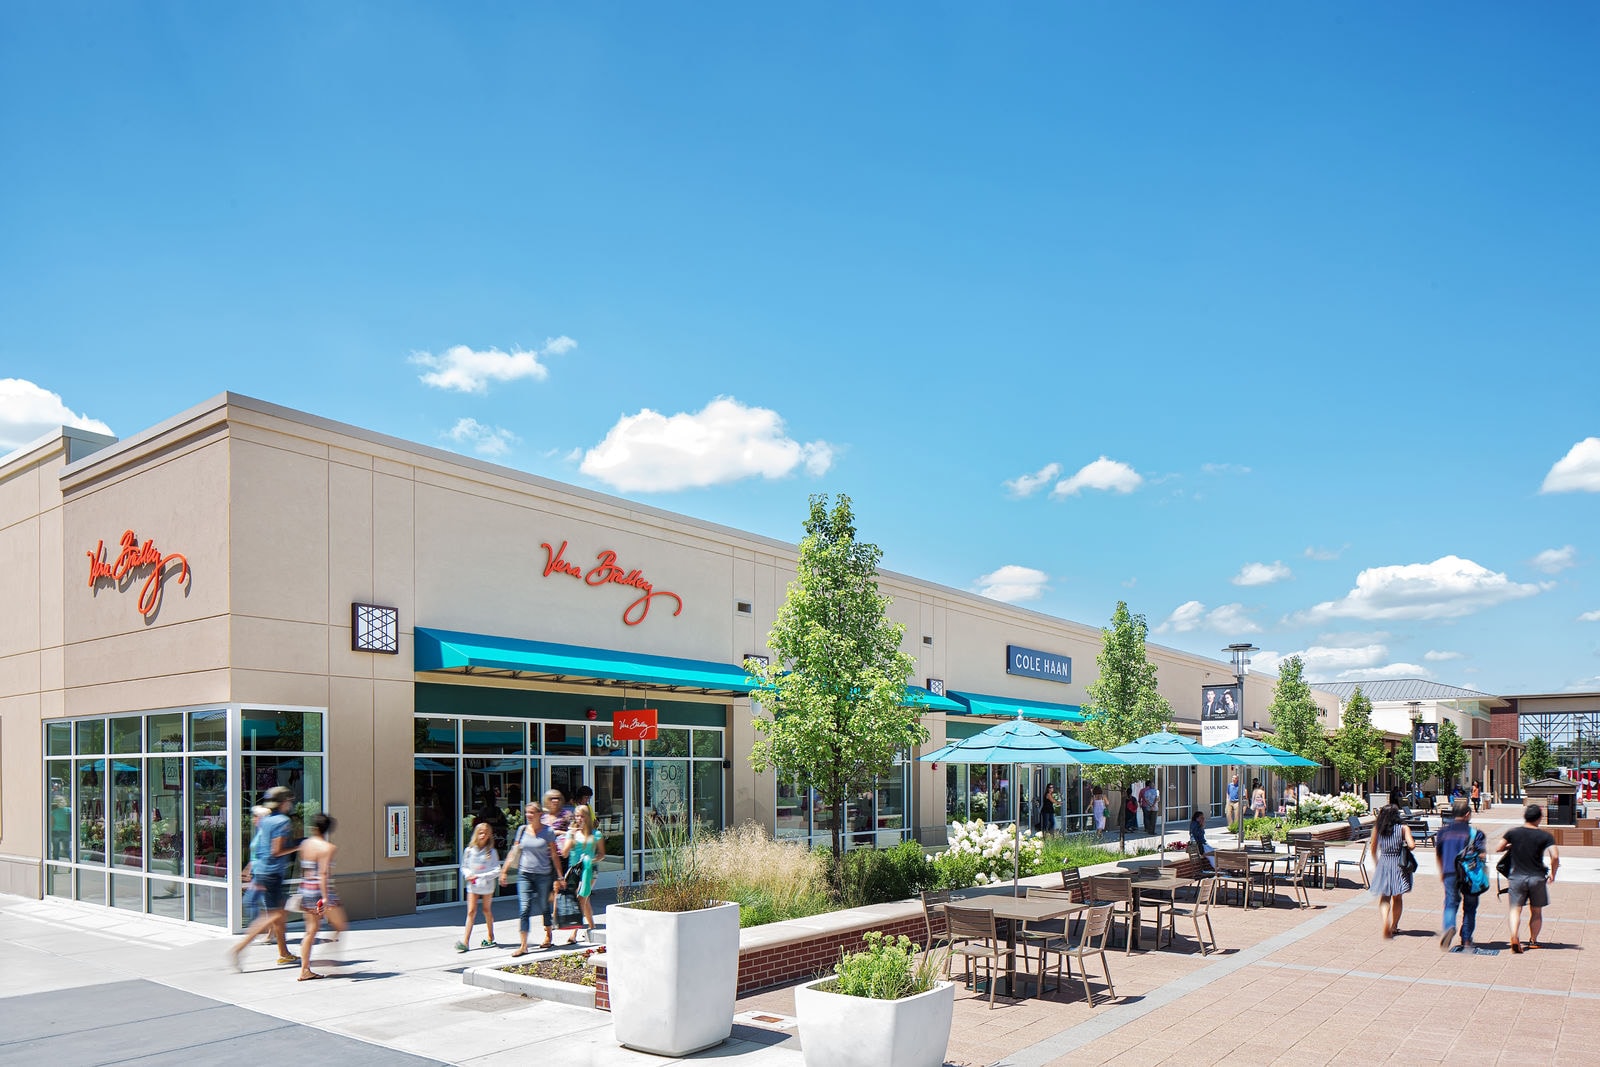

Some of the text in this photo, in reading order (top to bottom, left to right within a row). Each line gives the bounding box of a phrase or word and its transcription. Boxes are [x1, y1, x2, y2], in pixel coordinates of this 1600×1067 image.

[86, 529, 187, 614] Vera Bradley
[541, 540, 683, 626] Vera Bradley
[1015, 653, 1068, 676] COLE HAAN
[619, 717, 656, 738] Vera Bradley
